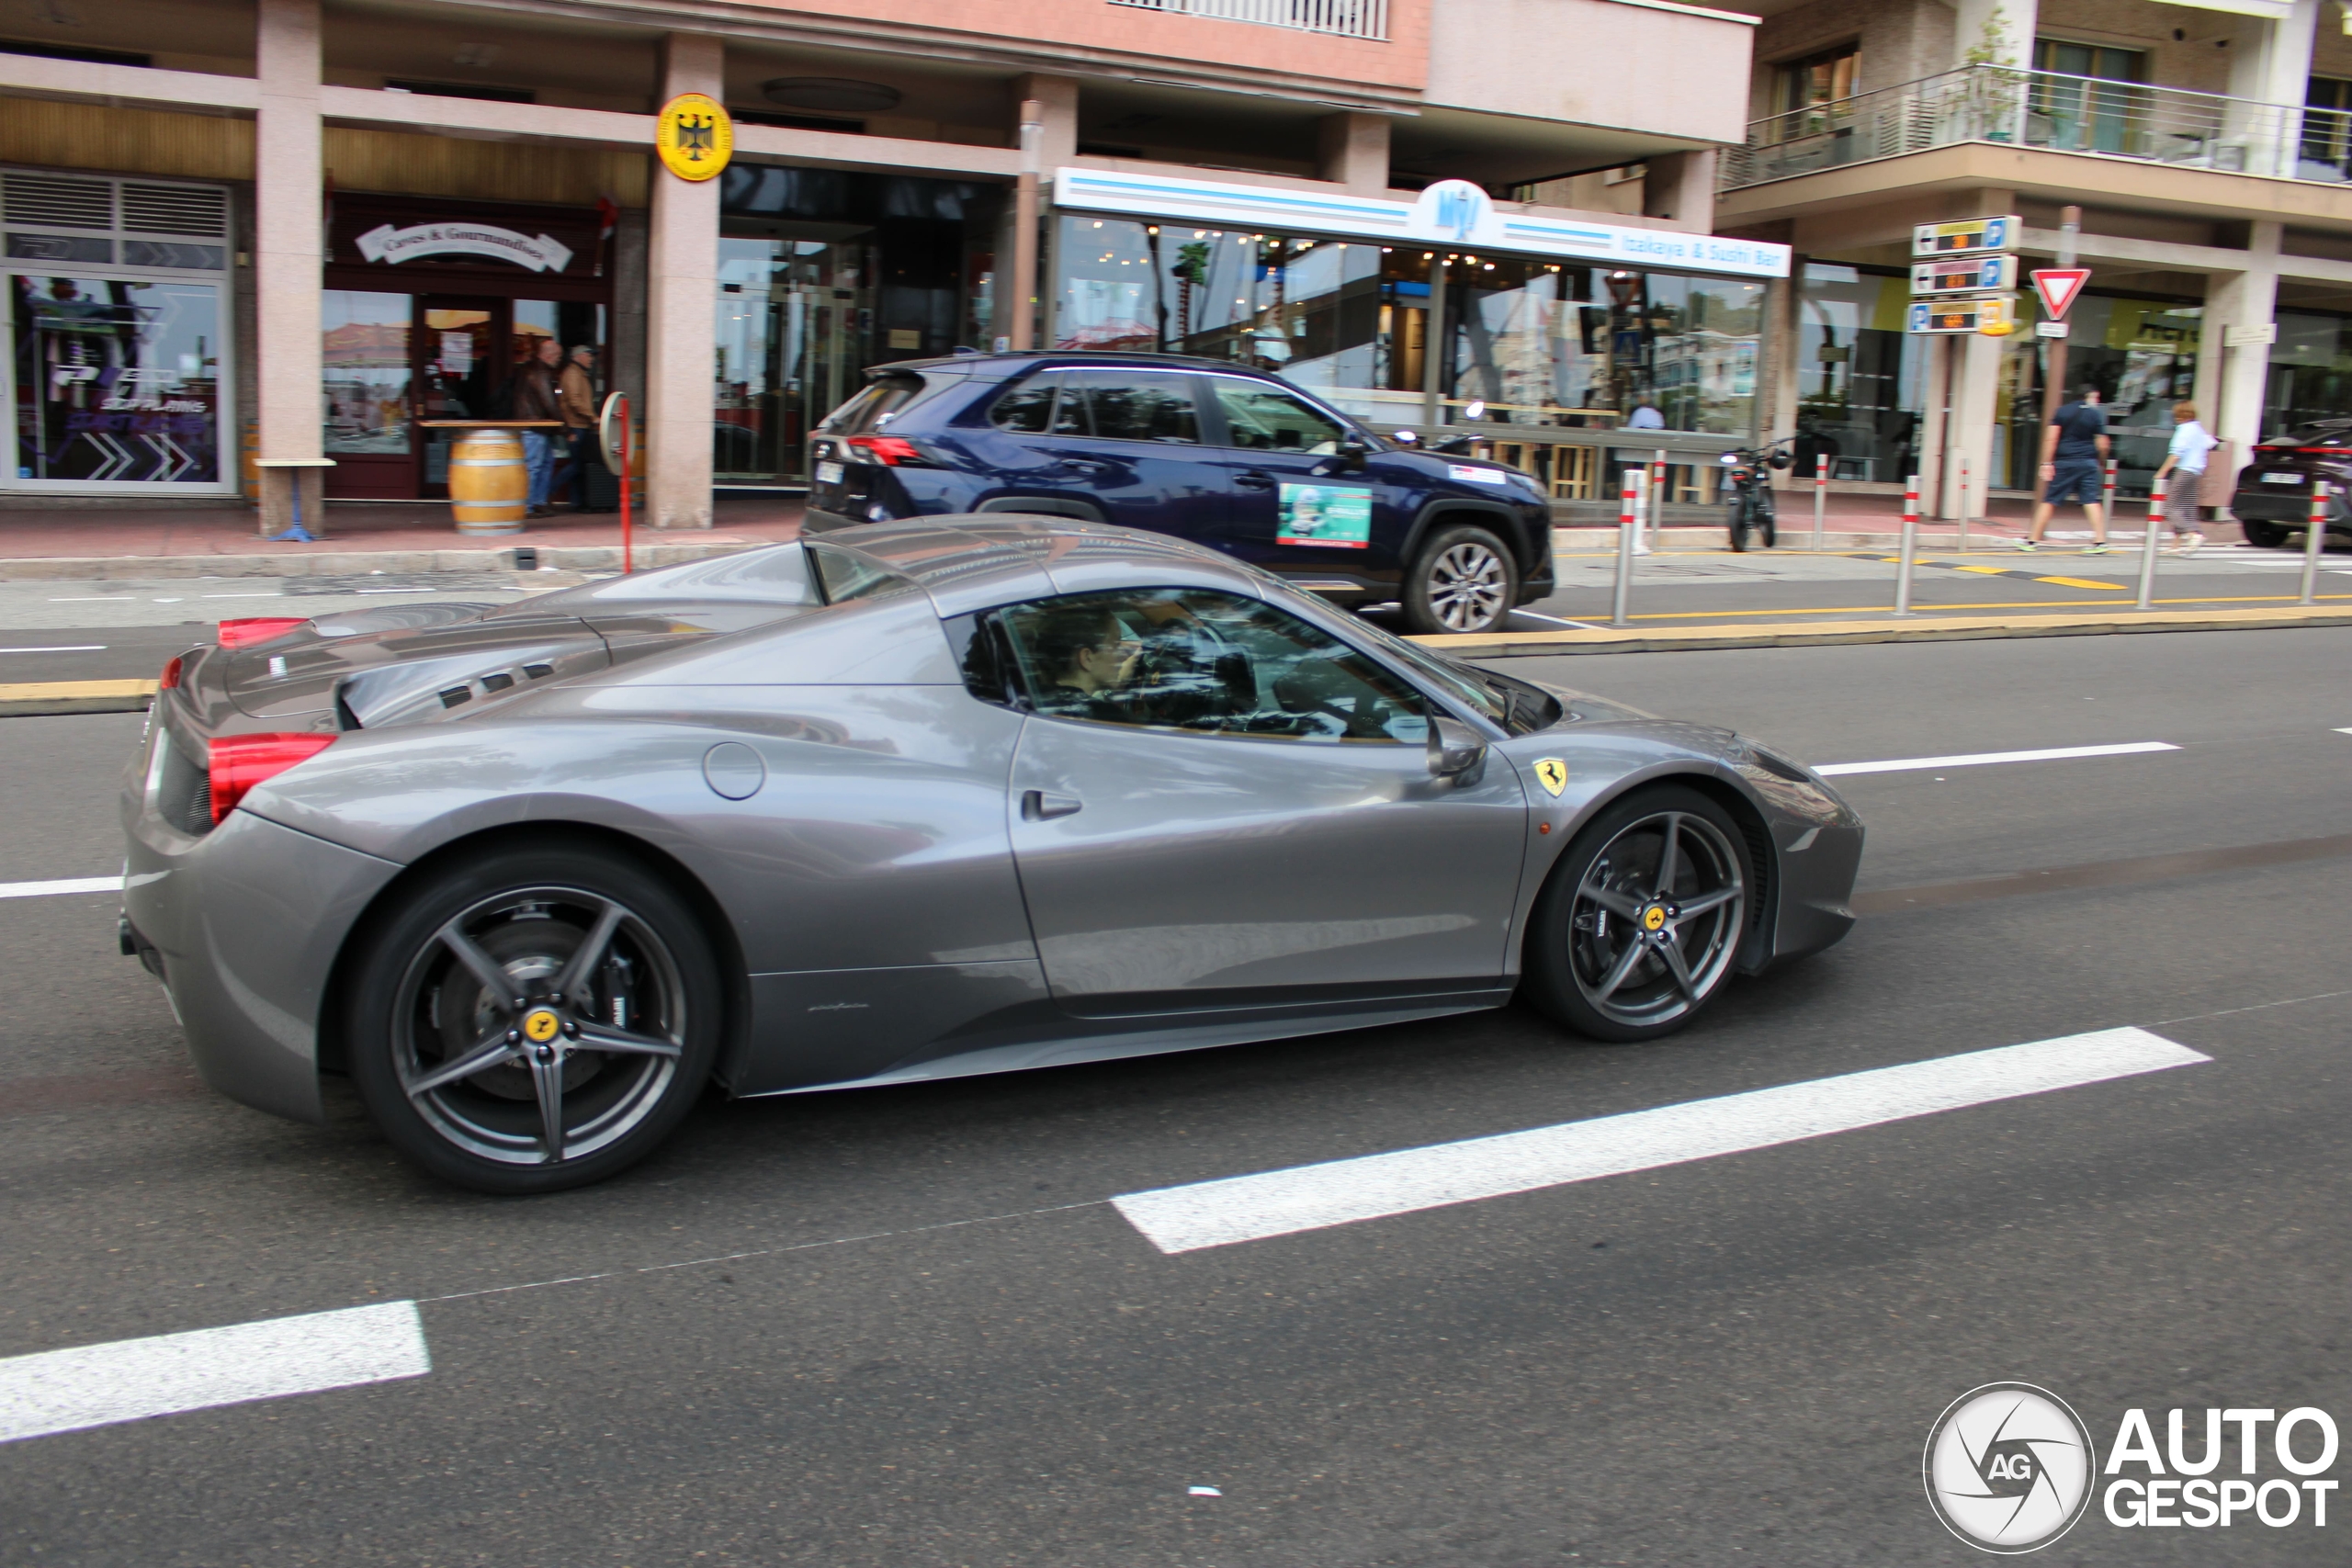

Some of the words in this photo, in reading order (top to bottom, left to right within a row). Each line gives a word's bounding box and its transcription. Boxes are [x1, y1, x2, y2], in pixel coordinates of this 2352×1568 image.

[428, 229, 444, 241] &
[446, 228, 546, 261] Gourmandises
[1622, 234, 1685, 260] Izakaya
[1691, 242, 1703, 258] &
[1708, 243, 1750, 265] Sushi
[1754, 250, 1781, 267] Bar
